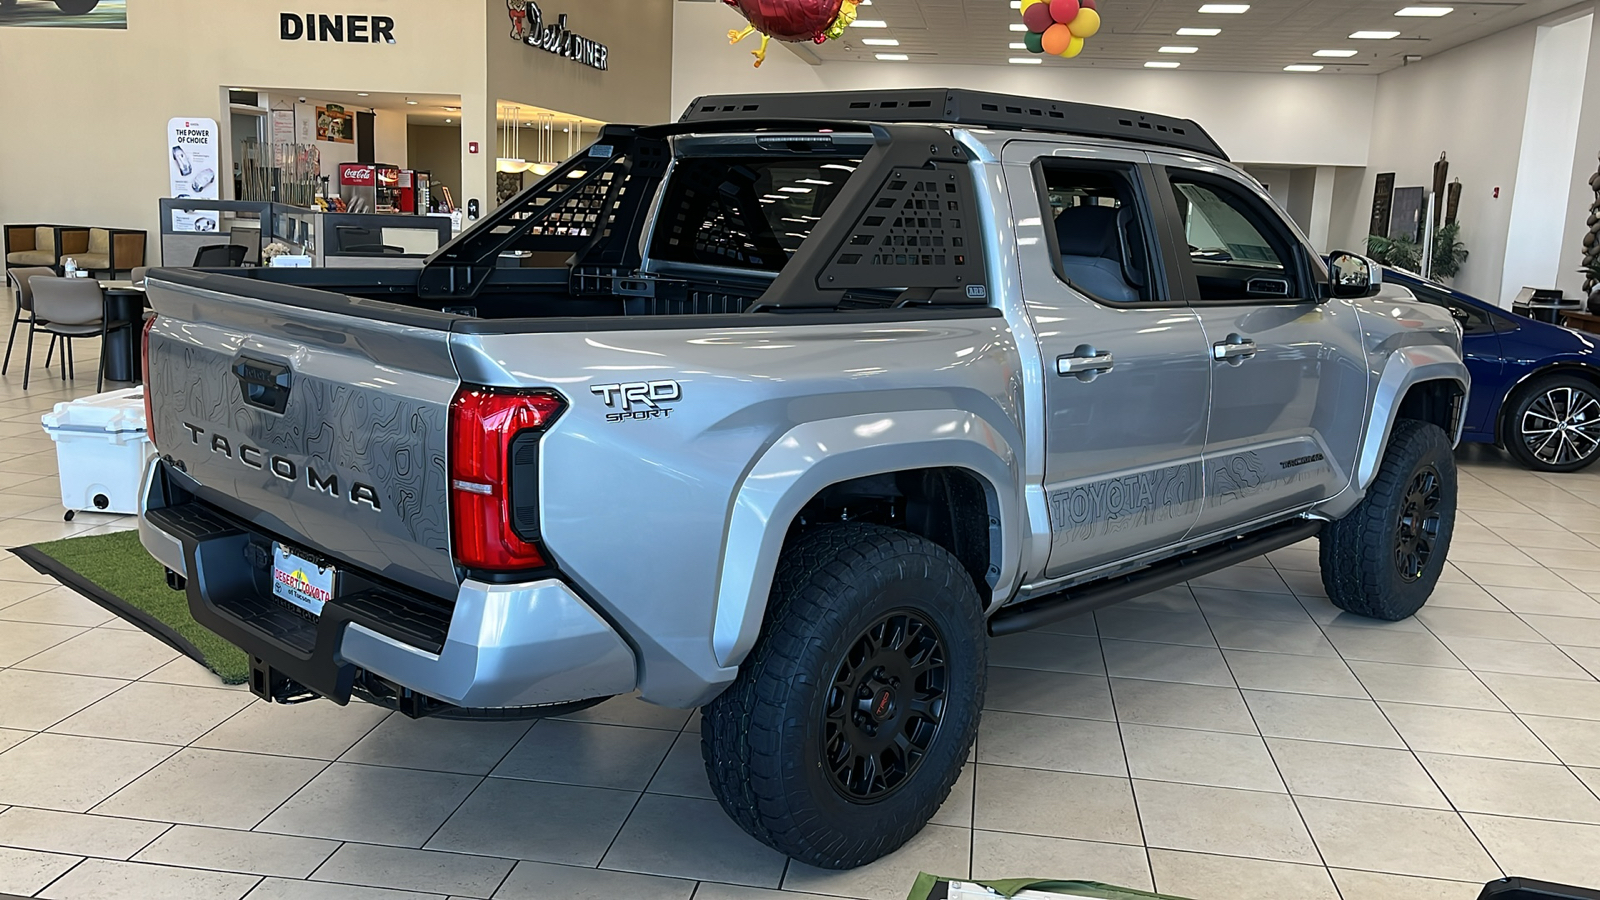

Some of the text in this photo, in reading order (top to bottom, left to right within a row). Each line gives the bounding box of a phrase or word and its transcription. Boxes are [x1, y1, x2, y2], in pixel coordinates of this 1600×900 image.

[280, 13, 396, 44] DINER
[575, 35, 608, 70] DINER
[590, 379, 683, 411] TRD
[606, 408, 674, 423] SPORT
[183, 421, 381, 512] TACOMA
[1053, 474, 1153, 527] TOYOTA
[275, 569, 330, 601] DESERT TOYOTA
[288, 588, 312, 604] of Tucson
[876, 691, 890, 714] TRD
